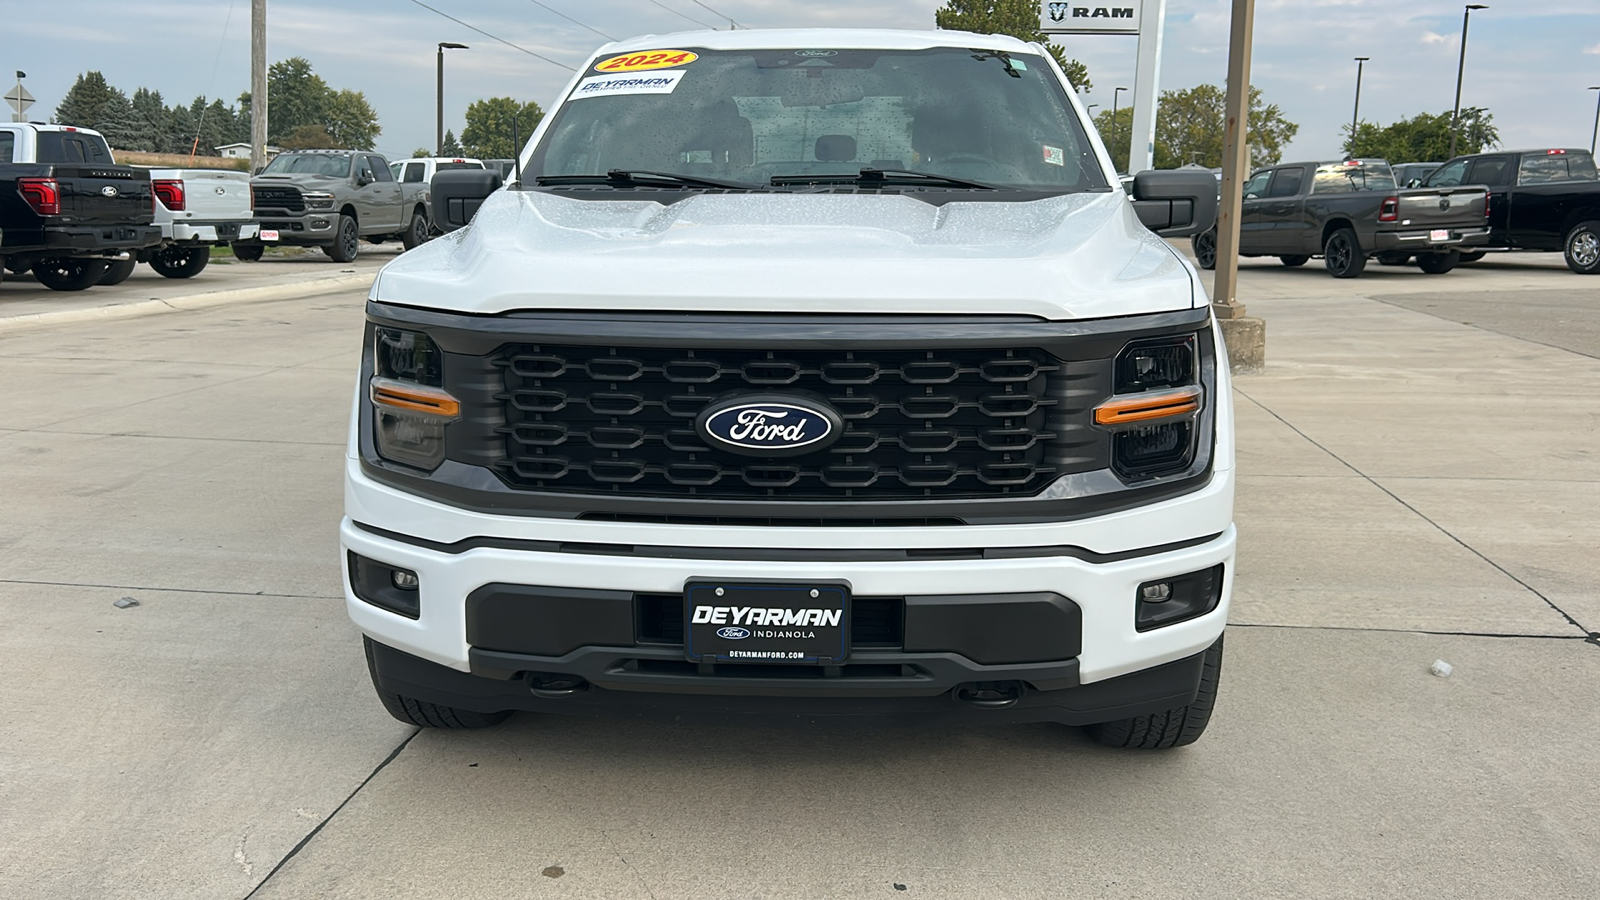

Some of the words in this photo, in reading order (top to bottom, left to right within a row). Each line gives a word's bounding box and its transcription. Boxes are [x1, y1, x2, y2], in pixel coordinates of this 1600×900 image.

[1072, 8, 1134, 18] RAM
[602, 53, 690, 69] 2024
[581, 78, 675, 91] DEYARMAN
[729, 409, 808, 441] Ford
[691, 605, 843, 627] DEYARMAN
[753, 630, 815, 638] INDIANOLA
[729, 650, 804, 659] DEYARMANFORD.COM
